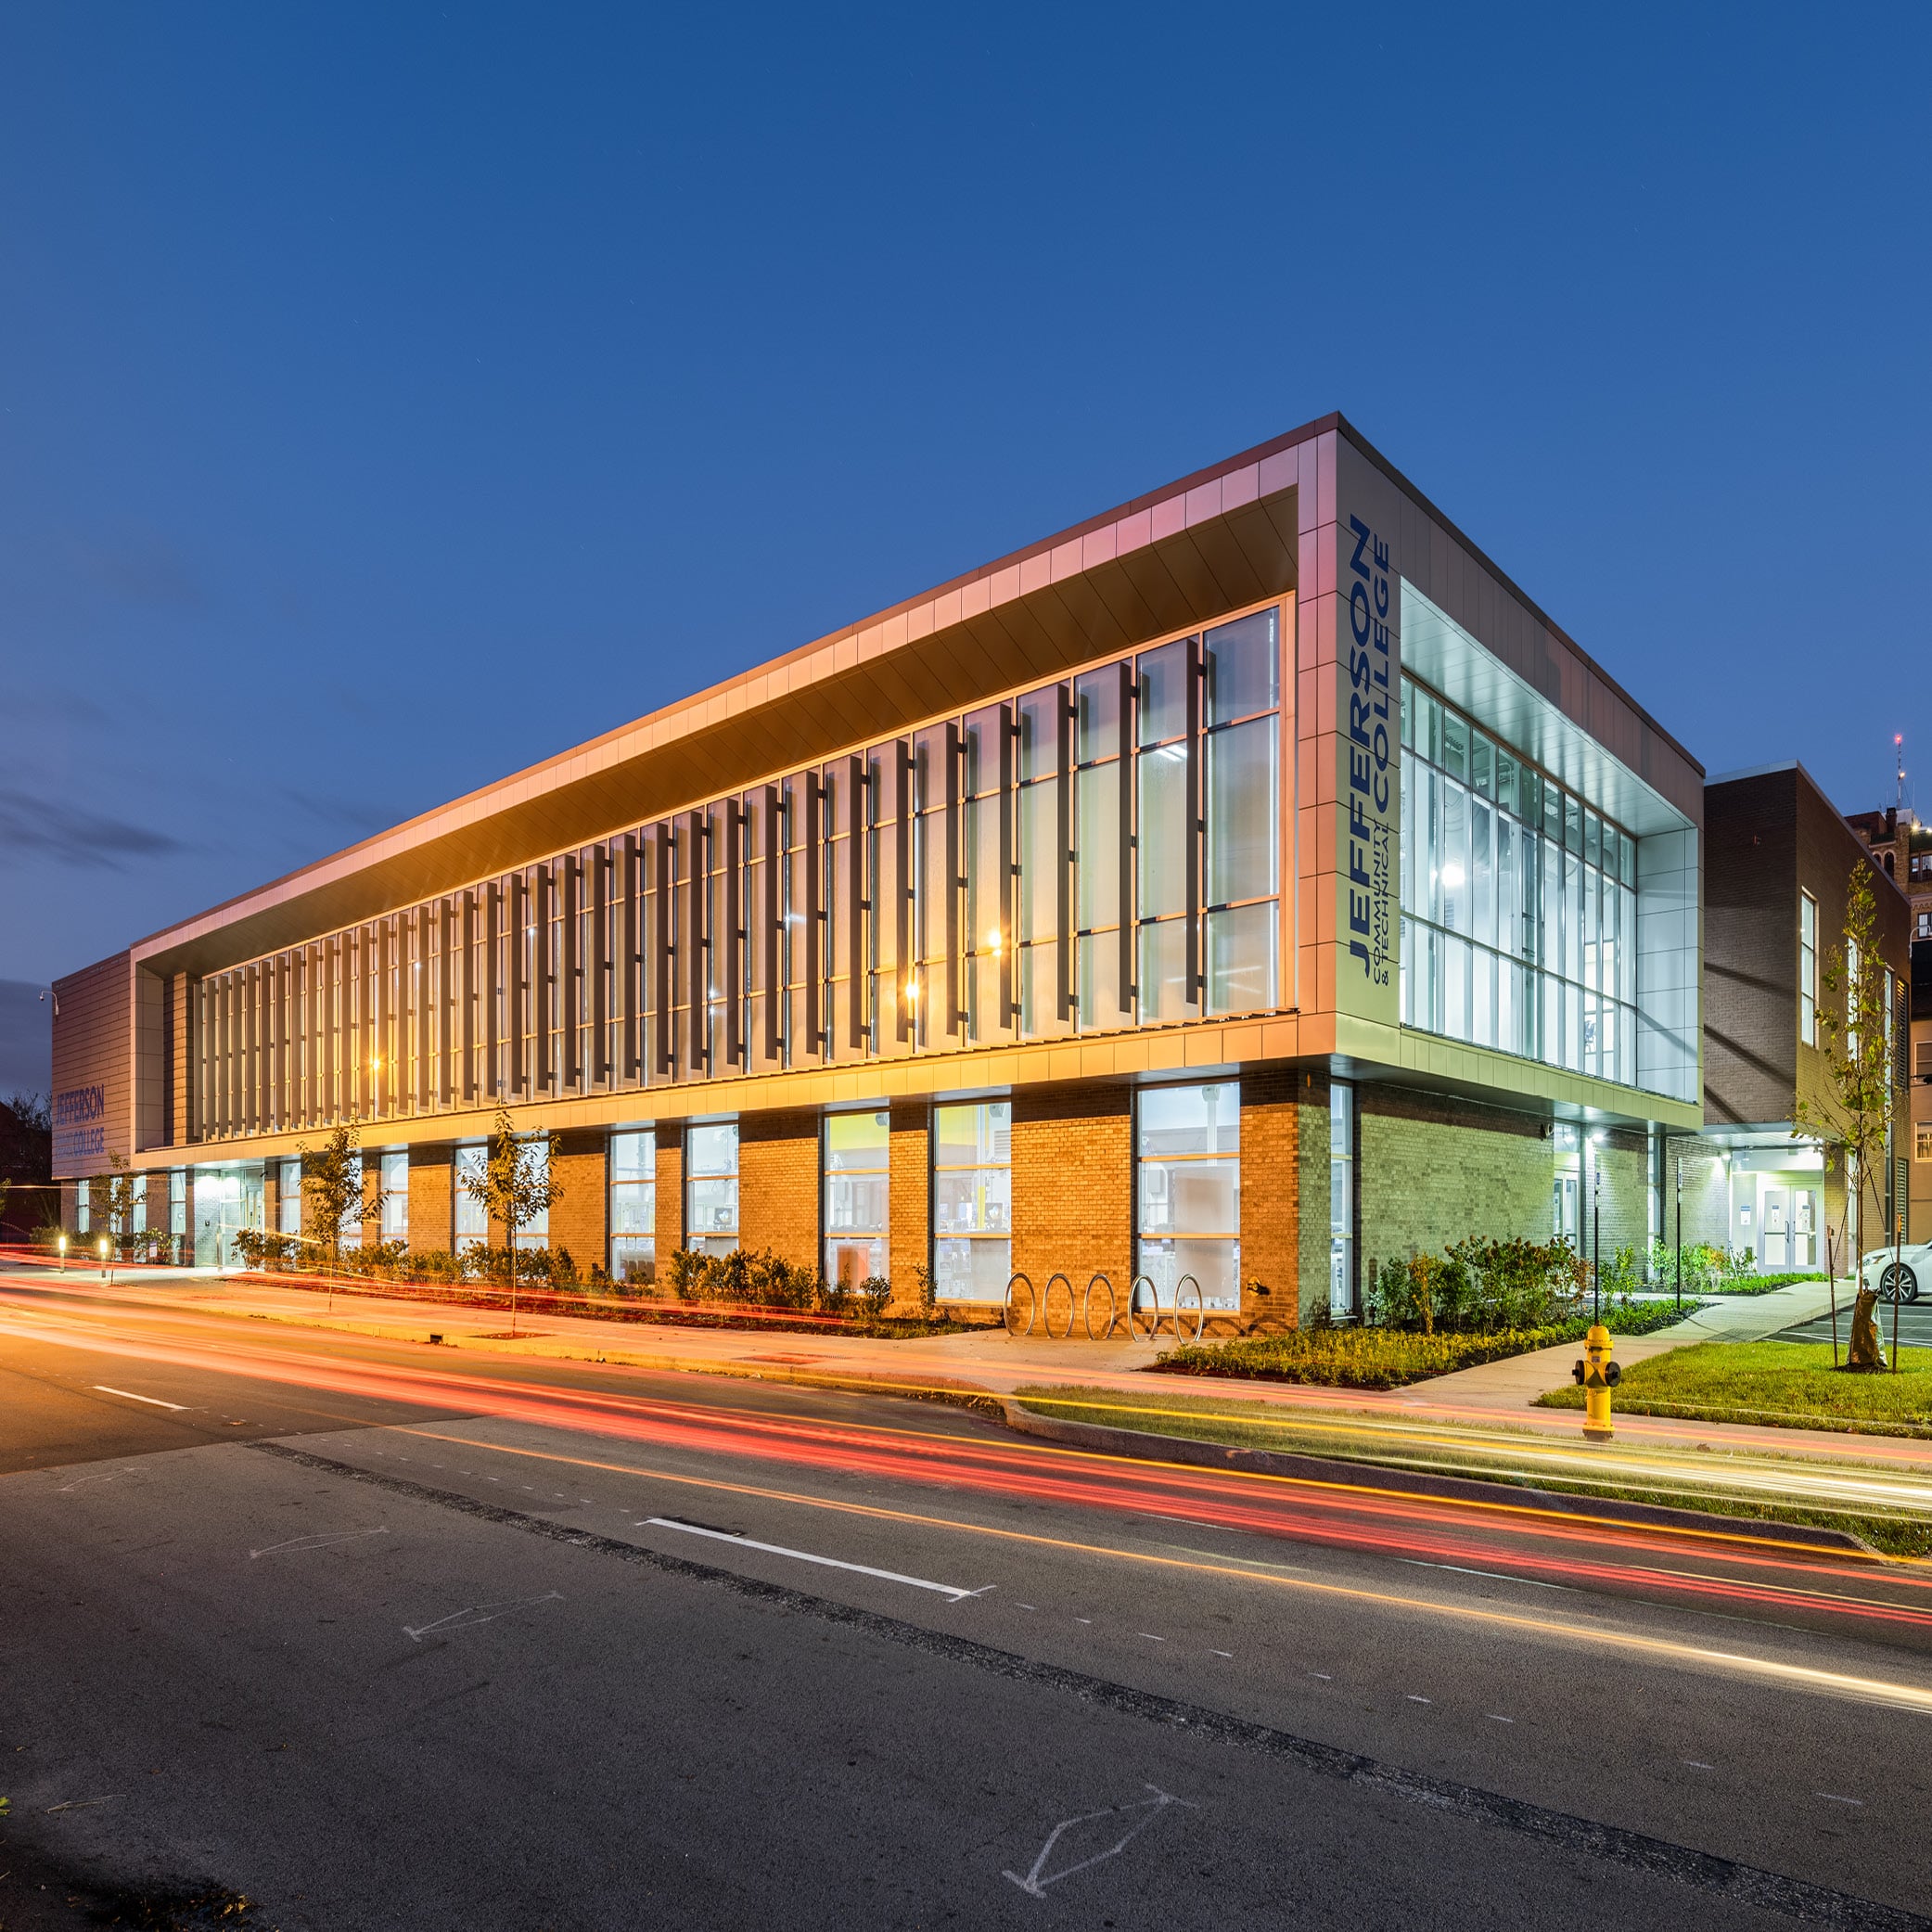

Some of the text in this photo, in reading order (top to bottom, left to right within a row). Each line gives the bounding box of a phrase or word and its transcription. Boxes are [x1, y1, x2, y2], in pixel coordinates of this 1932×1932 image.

[1374, 533, 1388, 813] COLLEGE
[1350, 513, 1370, 979] JEFFERSON
[1373, 818, 1381, 984] COMMUNITY
[1381, 970, 1388, 986] &
[56, 1083, 105, 1126] JEFFERSON
[73, 1127, 105, 1156] COLLEGE
